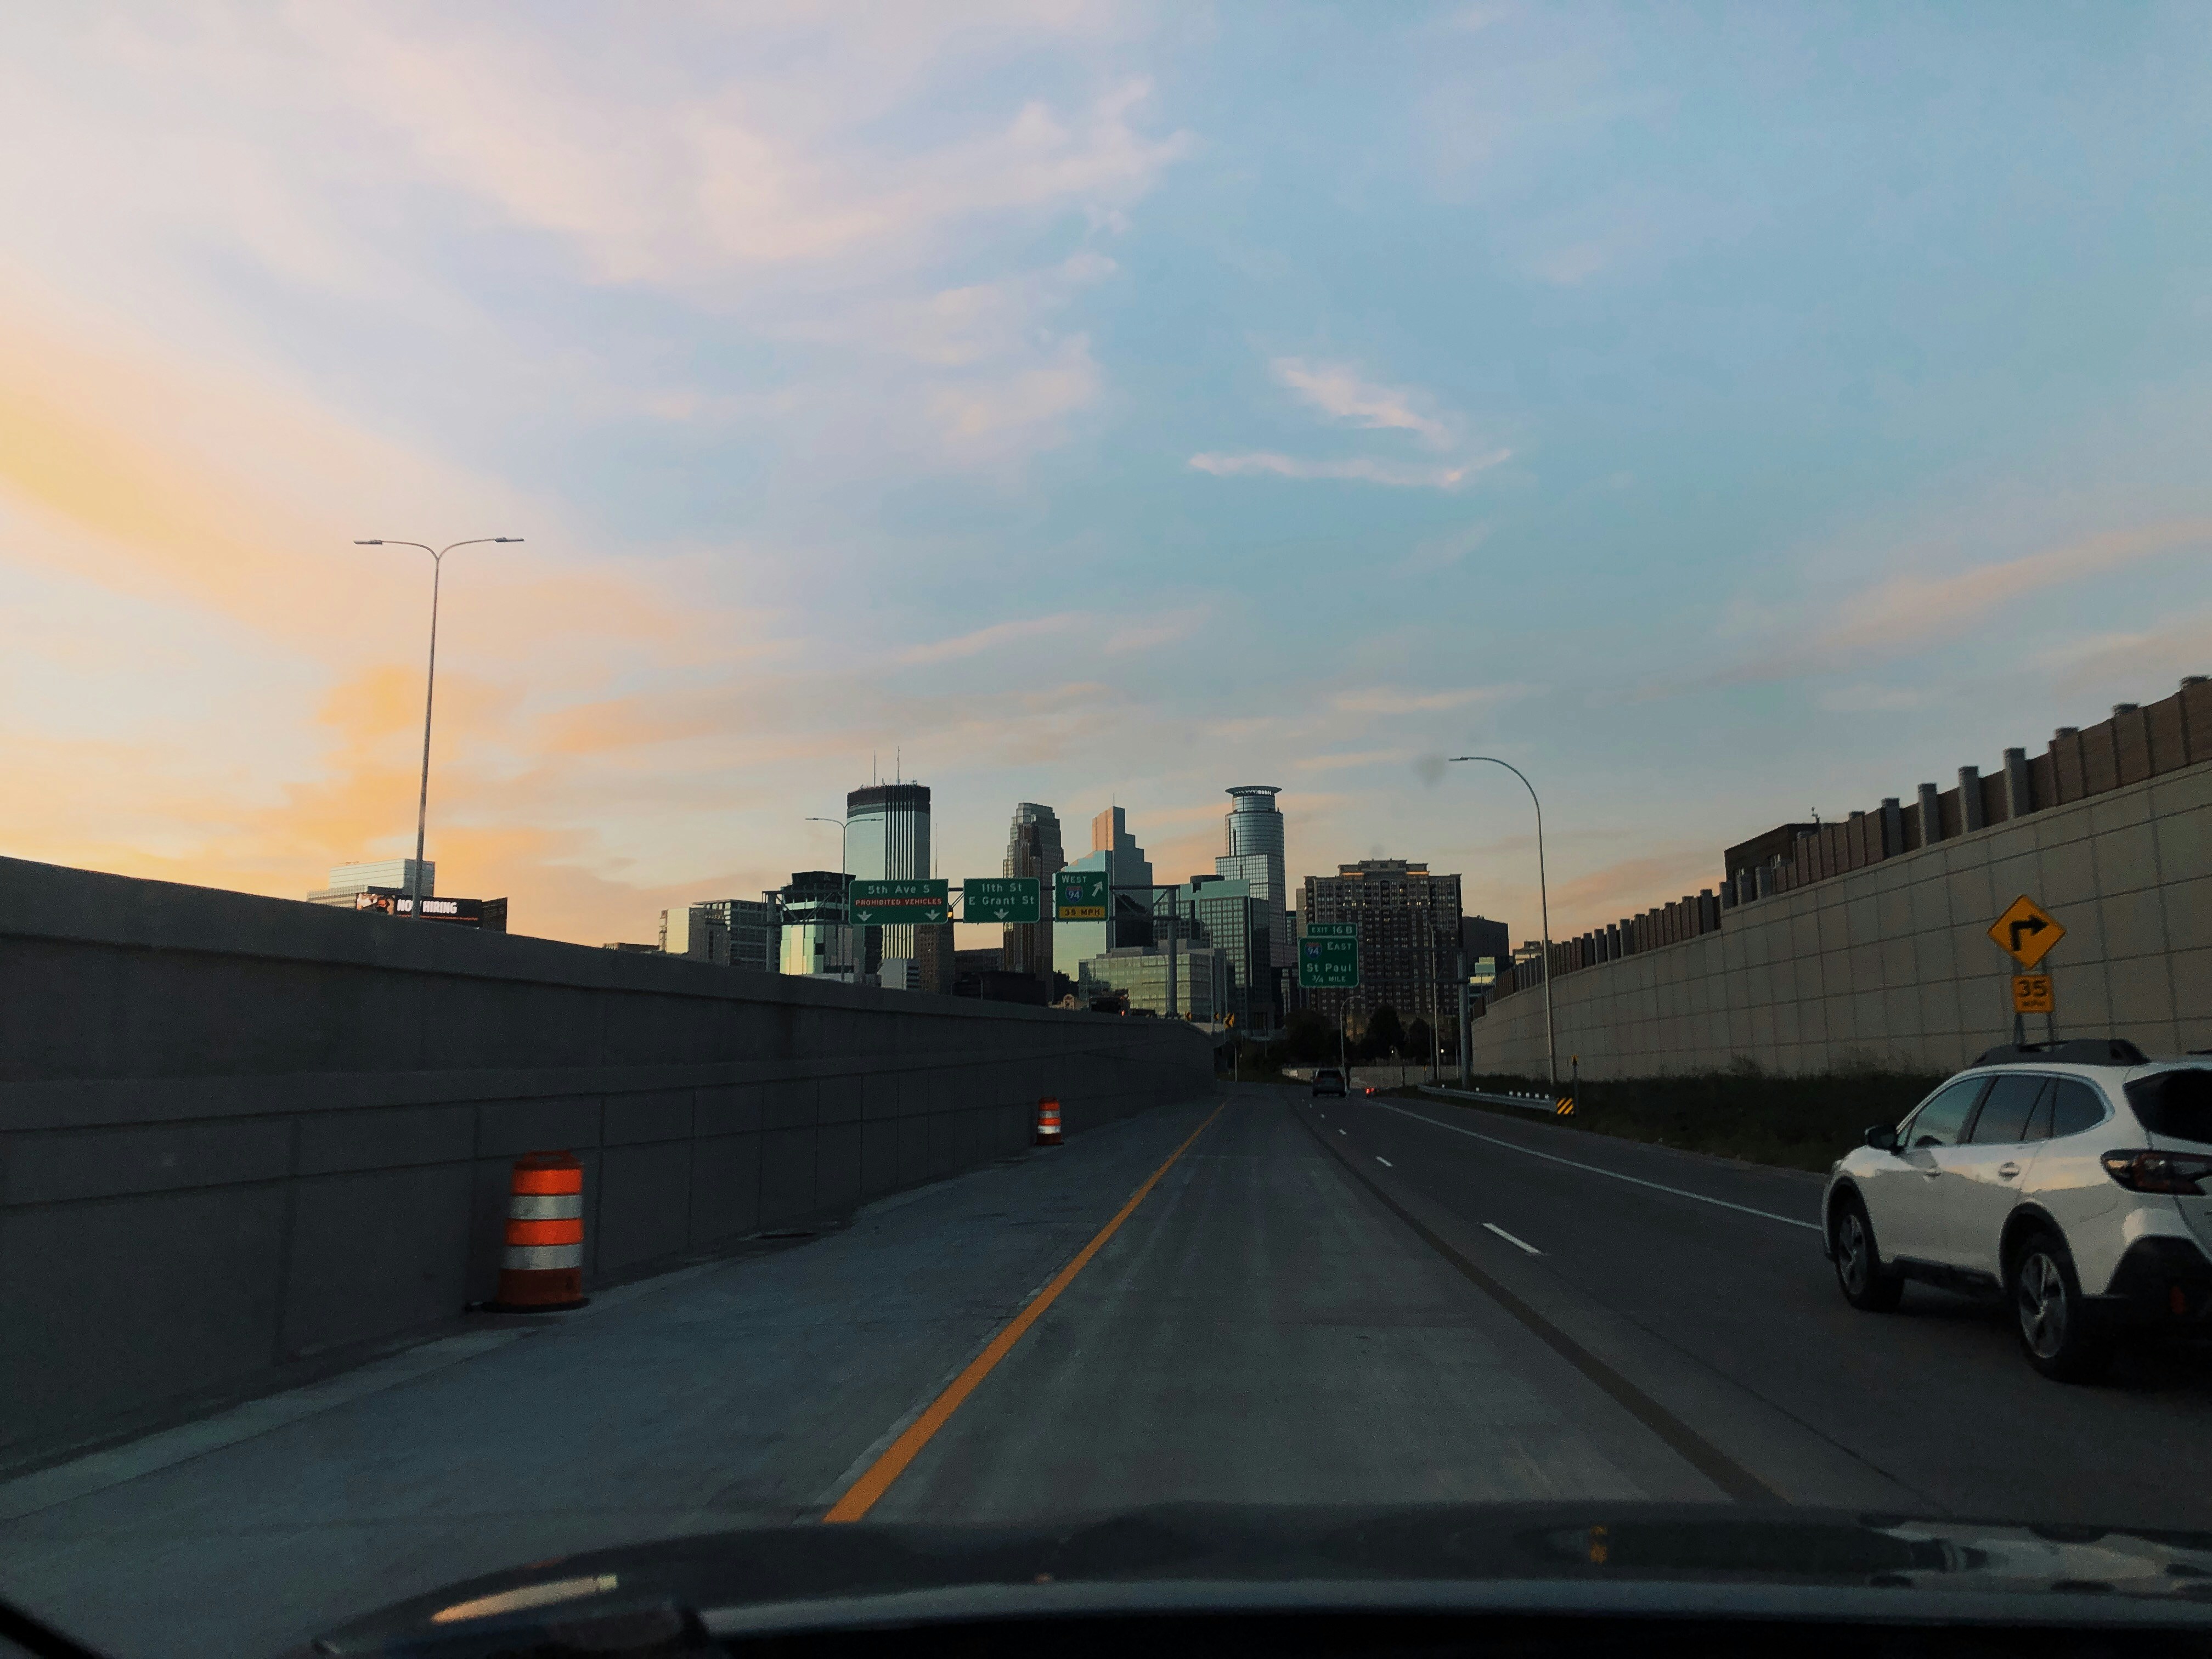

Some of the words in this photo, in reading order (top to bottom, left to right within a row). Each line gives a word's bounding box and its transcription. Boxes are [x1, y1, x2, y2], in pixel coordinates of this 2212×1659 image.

[1062, 875, 1087, 883] WEST
[868, 885, 888, 894] 5th
[895, 885, 916, 894] Ave
[923, 884, 930, 893] S
[982, 883, 1002, 892] 11th
[1010, 883, 1022, 892] St
[1068, 890, 1079, 899] 94
[969, 896, 975, 905] E
[983, 896, 1015, 905] Grant
[1022, 895, 1034, 905] St
[397, 899, 422, 912] NO
[423, 900, 458, 914] HIRING
[1327, 941, 1352, 950] EAST
[1307, 963, 1318, 972] St
[1325, 963, 1351, 972] Paul
[2018, 979, 2047, 997] 35
